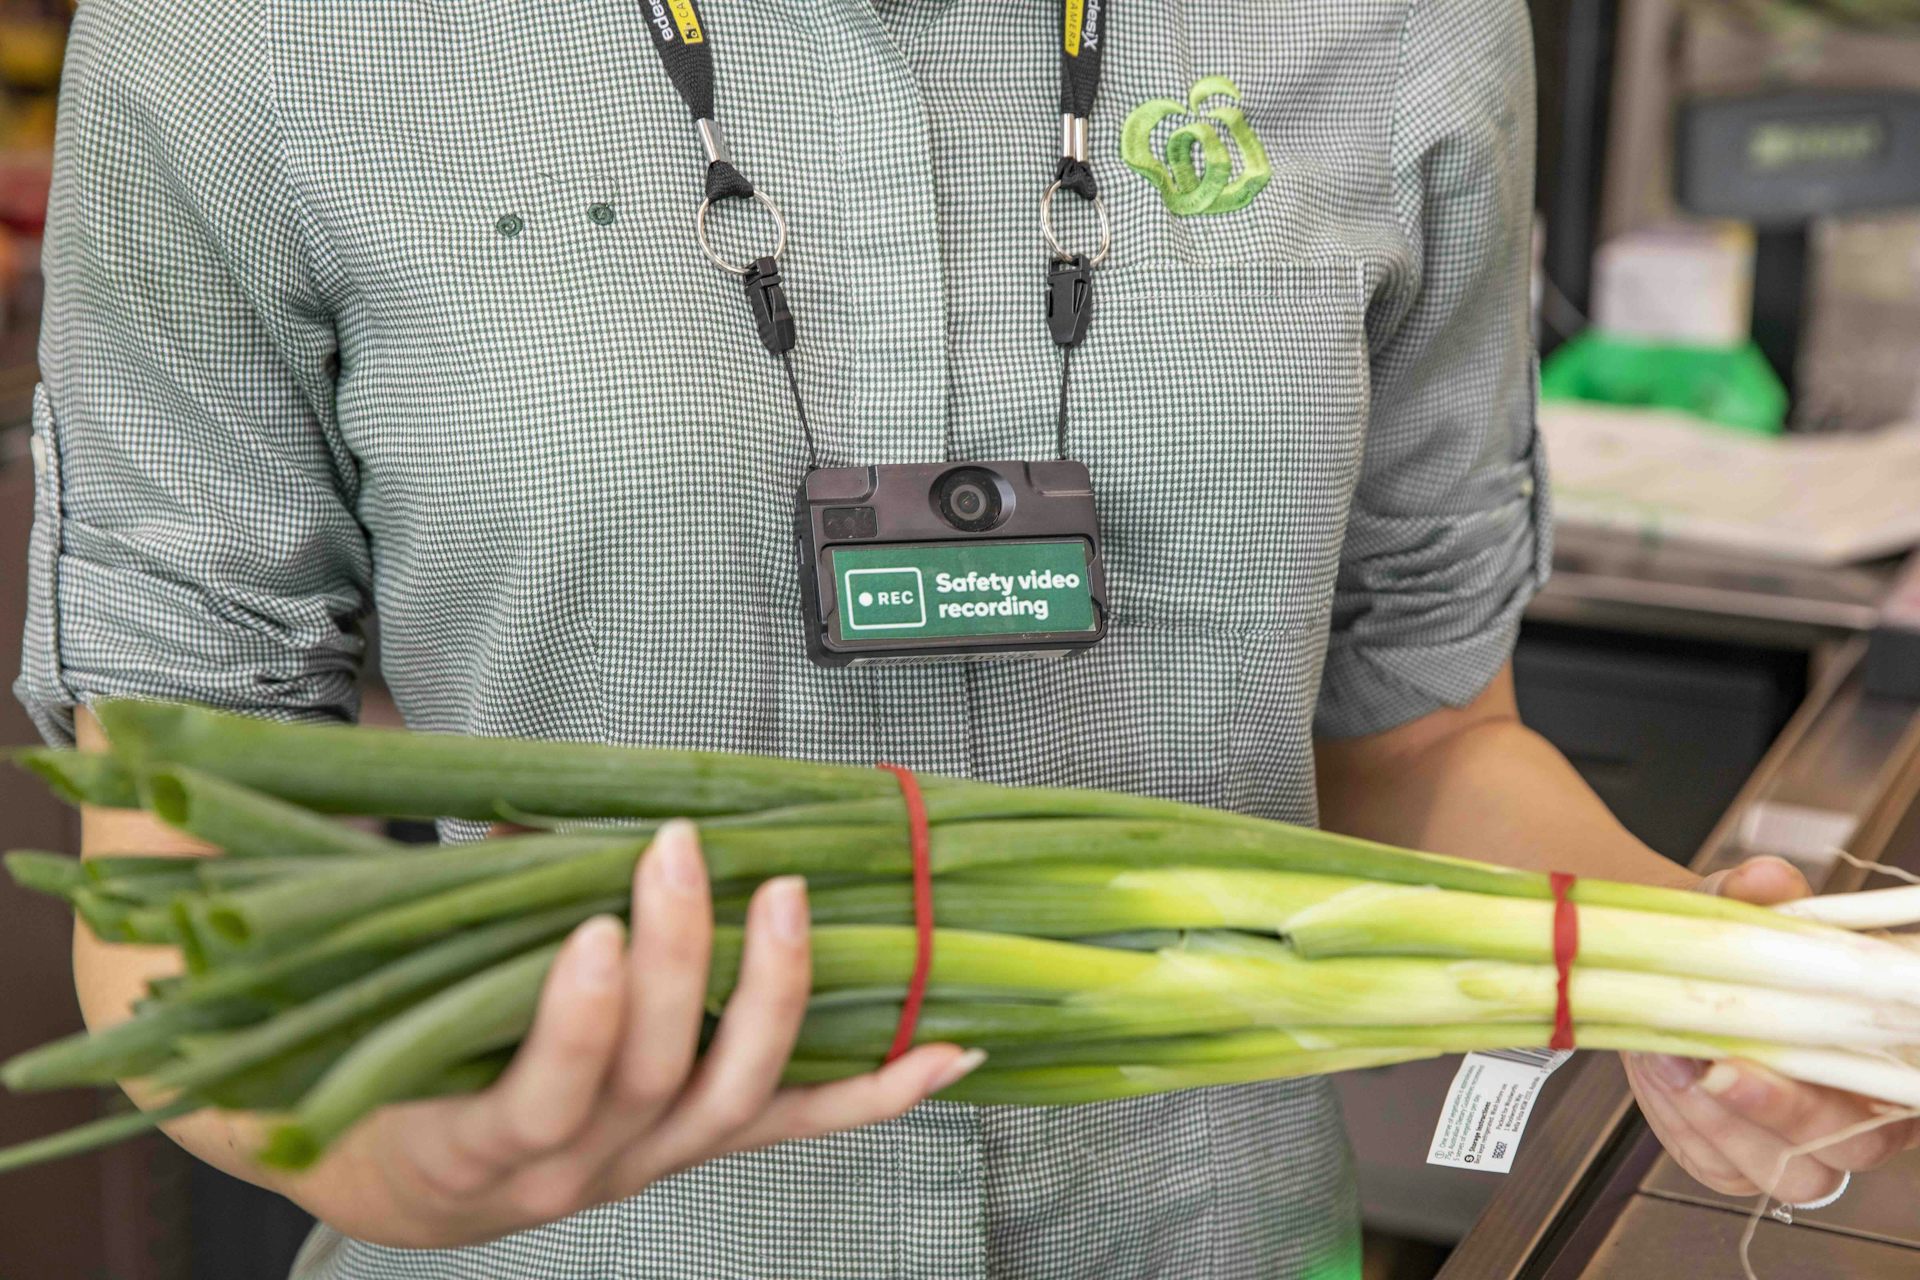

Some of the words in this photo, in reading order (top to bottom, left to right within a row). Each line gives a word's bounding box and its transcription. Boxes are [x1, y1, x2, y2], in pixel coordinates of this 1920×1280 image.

[935, 571, 1014, 596] Safety
[1017, 569, 1079, 591] video
[878, 591, 914, 605] REC
[938, 596, 1049, 620] recording
[1469, 1132, 1481, 1151] Storage
